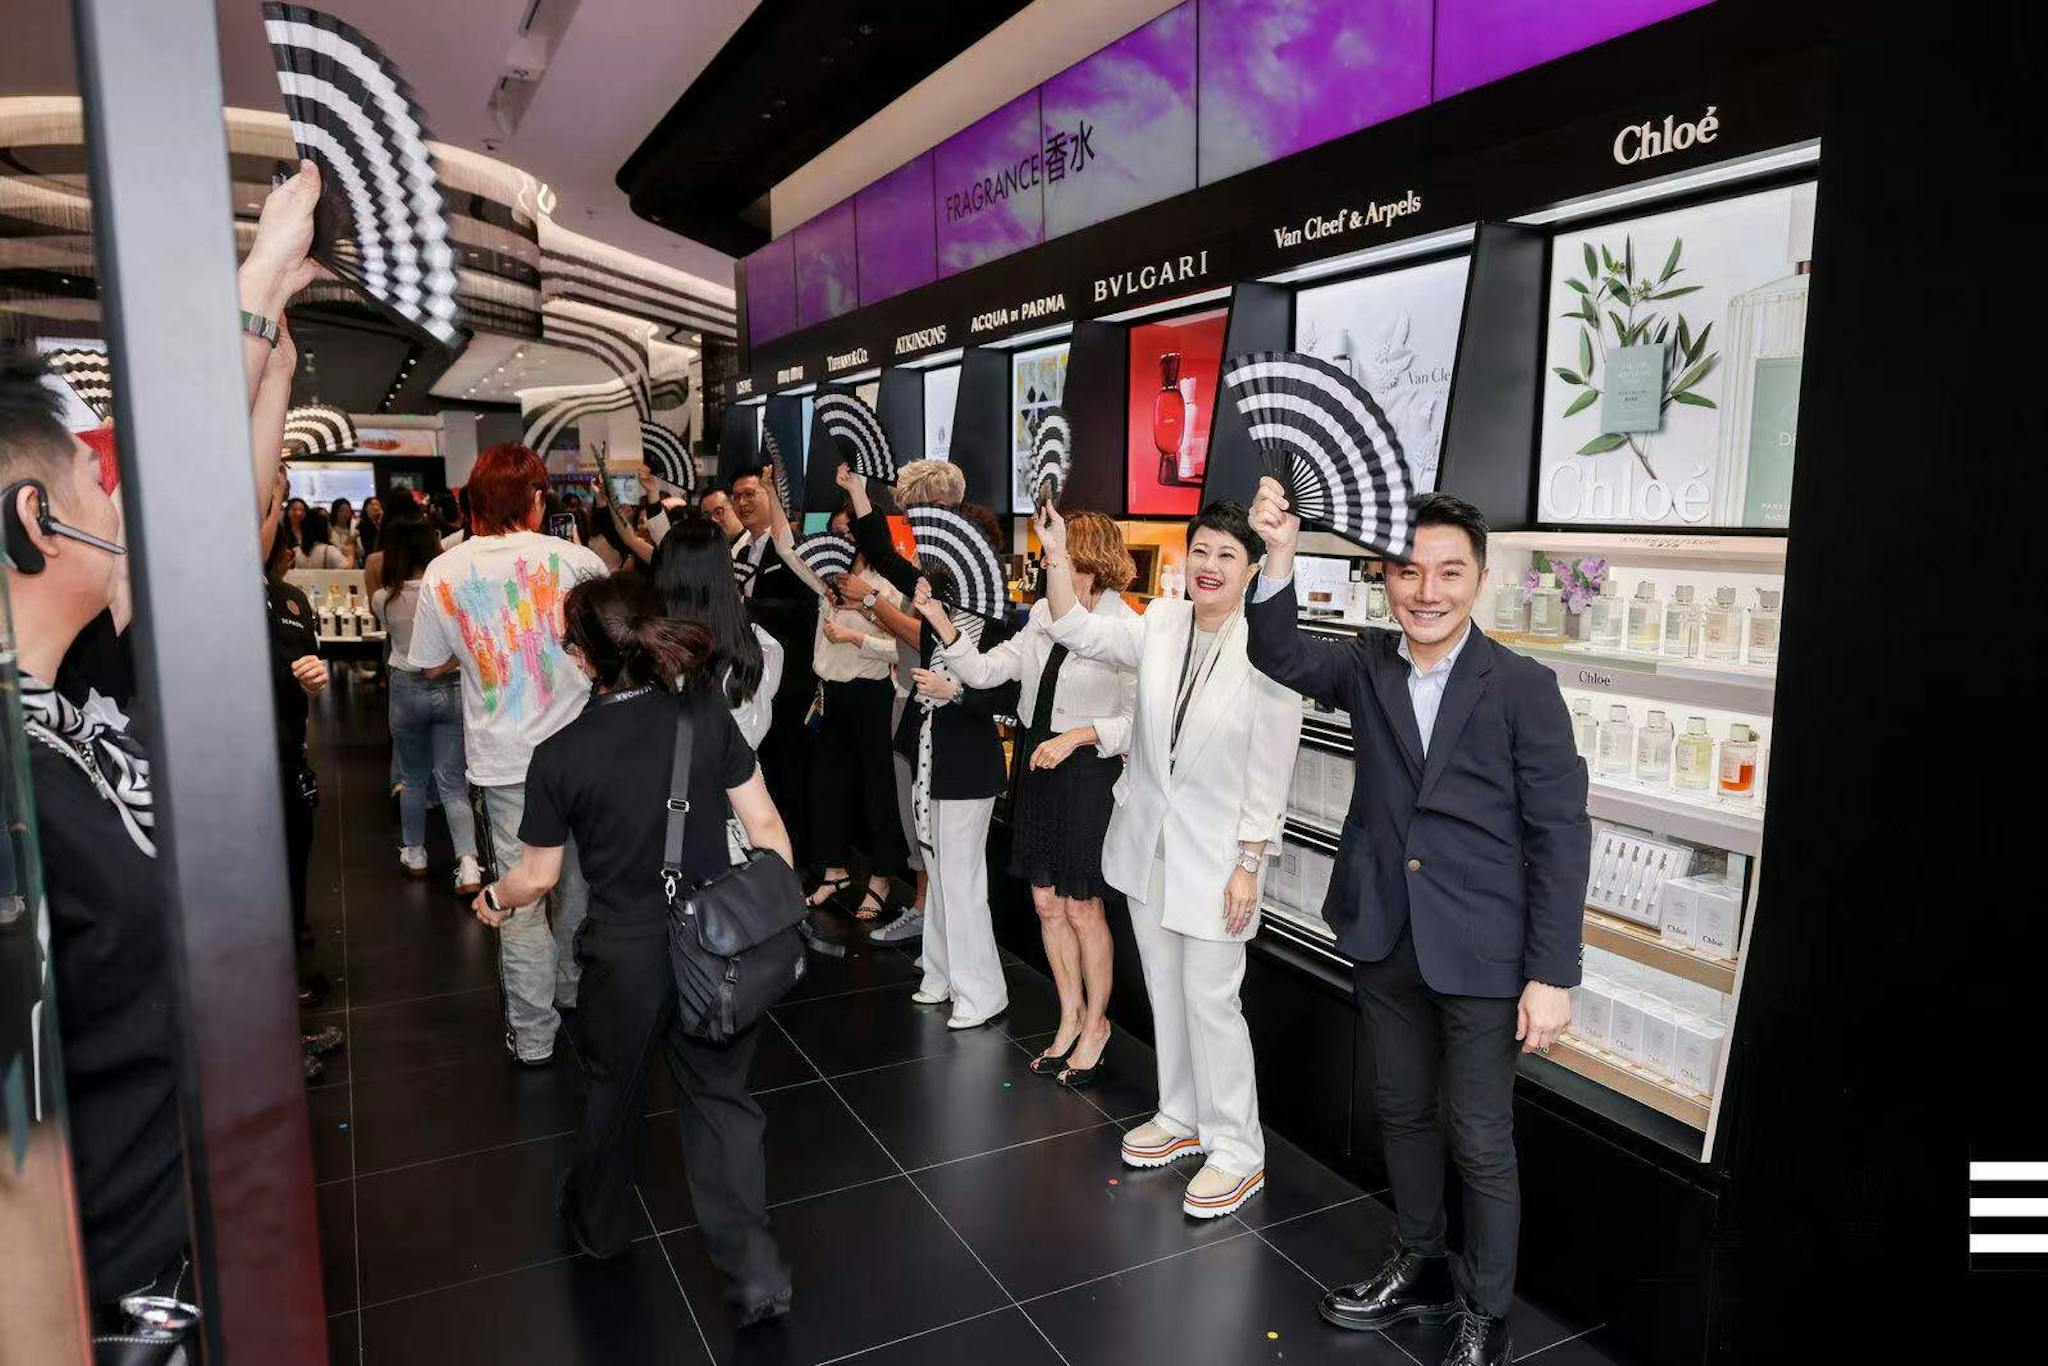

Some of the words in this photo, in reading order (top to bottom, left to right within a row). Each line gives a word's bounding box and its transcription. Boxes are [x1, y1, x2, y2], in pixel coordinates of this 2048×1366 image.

[1613, 106, 1719, 165] Chloé
[946, 154, 1040, 223] FRAGRANCE
[1046, 120, 1095, 184] 香水
[1274, 226, 1302, 249] Van
[1304, 209, 1348, 241] Cleef
[1349, 211, 1364, 230] &
[1364, 190, 1422, 228] Arpels
[1094, 250, 1208, 303] BVLGARI
[895, 324, 948, 355] ATKINSONS
[971, 309, 1009, 333] ACQUA
[1021, 293, 1065, 320] PARMA
[1542, 460, 1711, 524] Chloé
